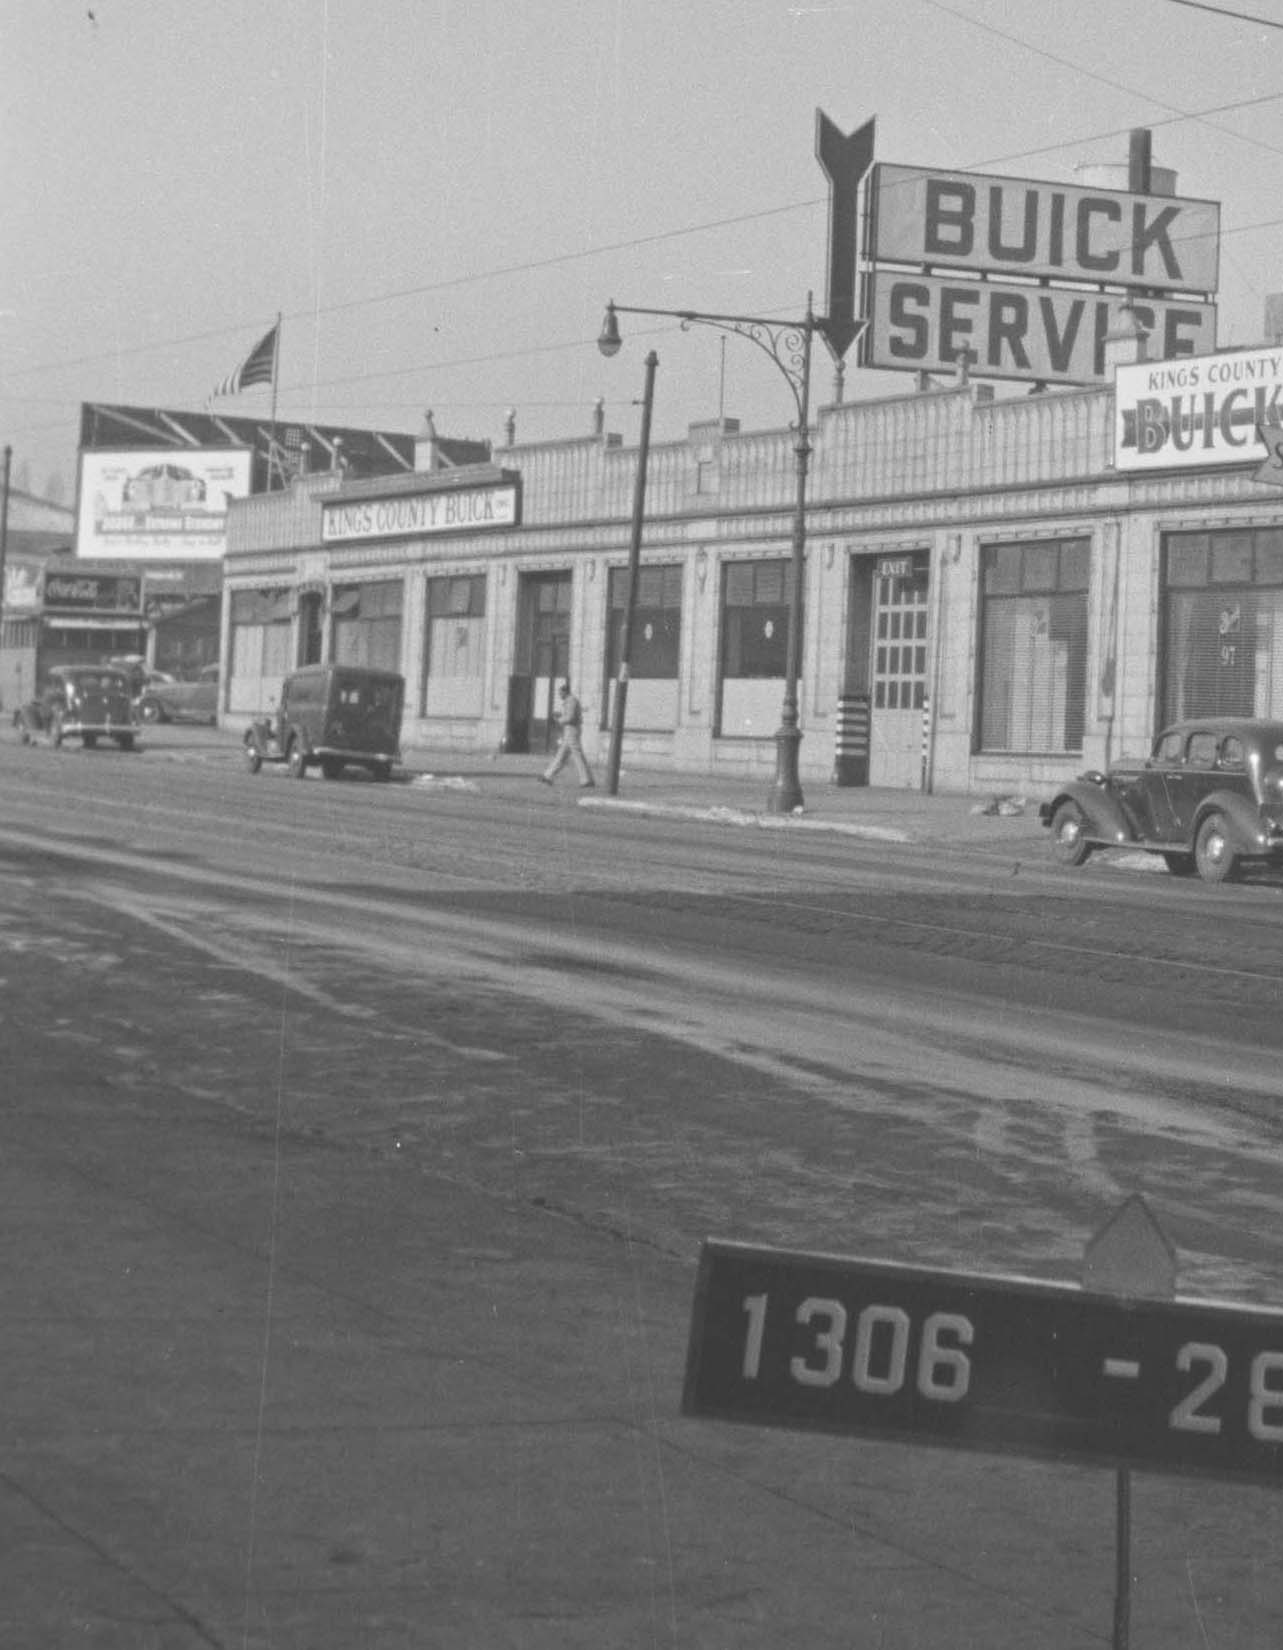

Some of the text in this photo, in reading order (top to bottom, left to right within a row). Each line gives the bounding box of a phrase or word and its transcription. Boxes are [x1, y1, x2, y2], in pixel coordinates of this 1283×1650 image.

[923, 179, 1184, 281] BUICK
[1148, 356, 1282, 391] KINGS COUNTY
[1136, 384, 1283, 455] BUICK
[327, 505, 372, 537] KINGS
[375, 498, 440, 531] COUNTY
[446, 491, 496, 524] BUICK
[882, 560, 908, 576] EXIT
[740, 1291, 976, 1401] 1306
